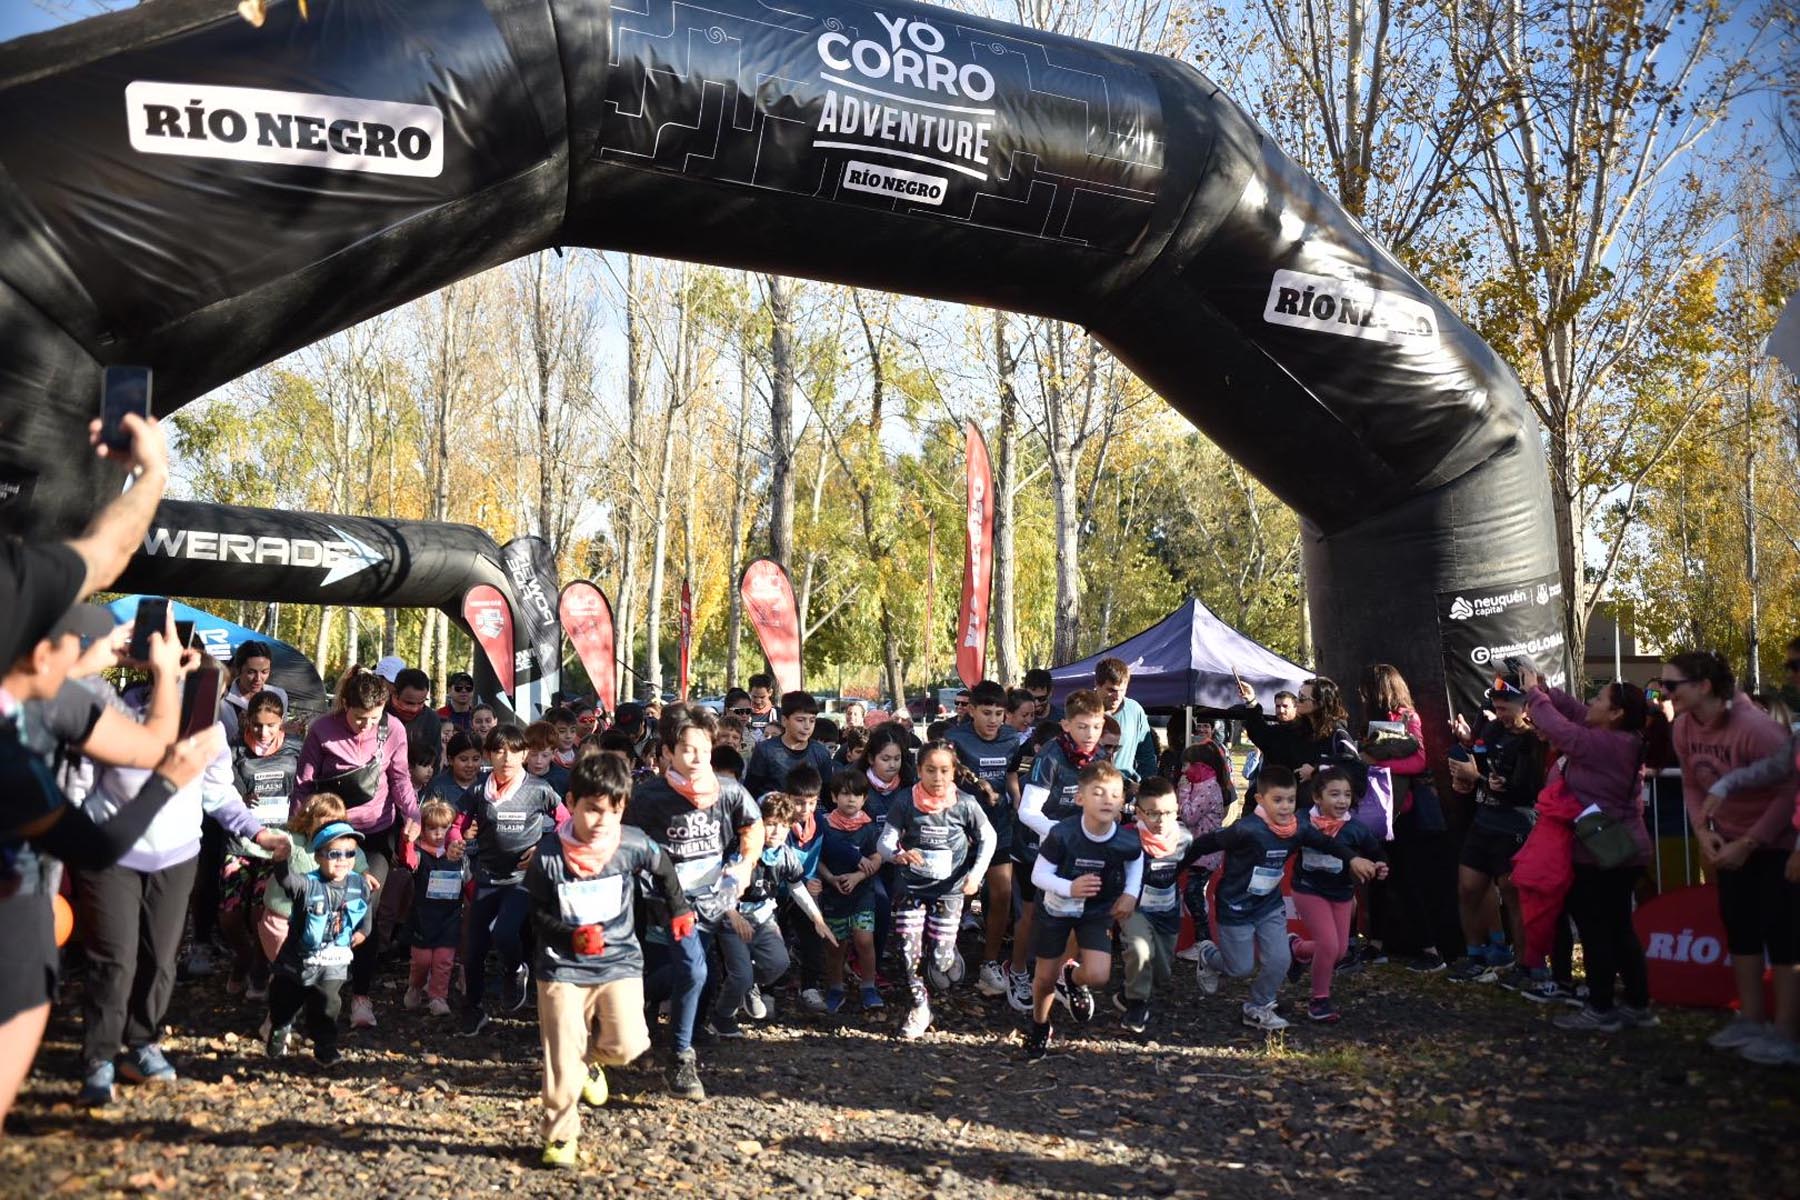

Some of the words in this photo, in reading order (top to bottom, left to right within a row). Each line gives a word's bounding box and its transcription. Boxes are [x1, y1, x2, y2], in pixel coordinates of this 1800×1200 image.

[874, 12, 945, 53] YO
[818, 32, 995, 101] CORRO
[143, 99, 248, 144] RÍO
[255, 111, 432, 161] NEGRO
[817, 89, 992, 165] ADVENTURE
[848, 169, 881, 188] RÍO
[882, 177, 941, 199] NEGRO
[1274, 285, 1336, 320] RÍO
[1474, 589, 1527, 607] neuquén
[1475, 605, 1504, 617] capital
[666, 820, 720, 838] CORRO
[684, 812, 707, 826] YO
[1646, 929, 1720, 965] RÍO
